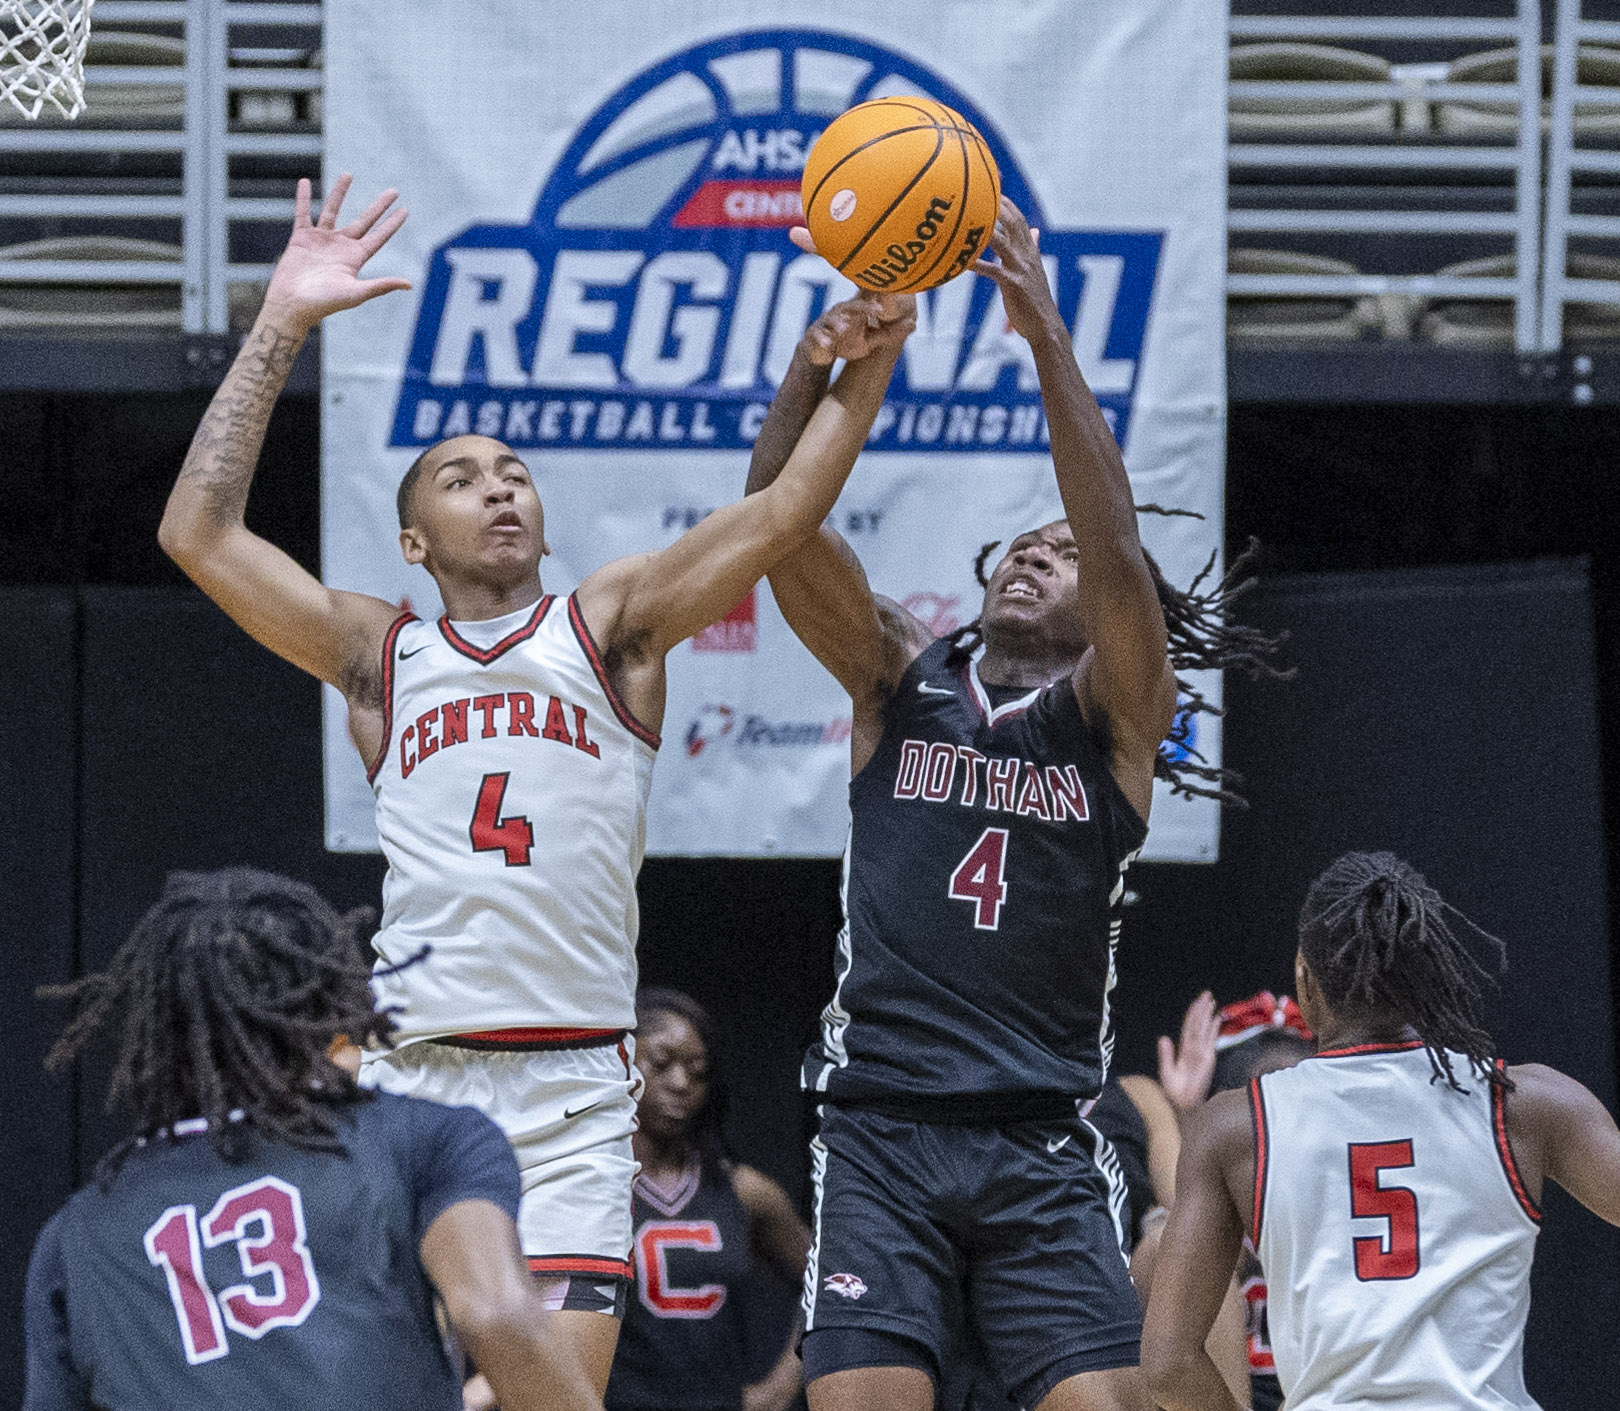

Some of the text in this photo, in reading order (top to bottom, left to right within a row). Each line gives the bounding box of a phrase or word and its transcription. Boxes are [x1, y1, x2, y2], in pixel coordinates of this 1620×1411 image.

[855, 196, 953, 288] Wilson
[413, 399, 716, 441] BASKETBALL
[400, 692, 601, 779] CENTRAL
[893, 739, 1090, 822] DOTHAN
[468, 771, 535, 867] 4
[948, 826, 1009, 931] 4
[1347, 1137, 1420, 1282] 5
[144, 1175, 320, 1365] 13
[637, 1220, 725, 1319] C
